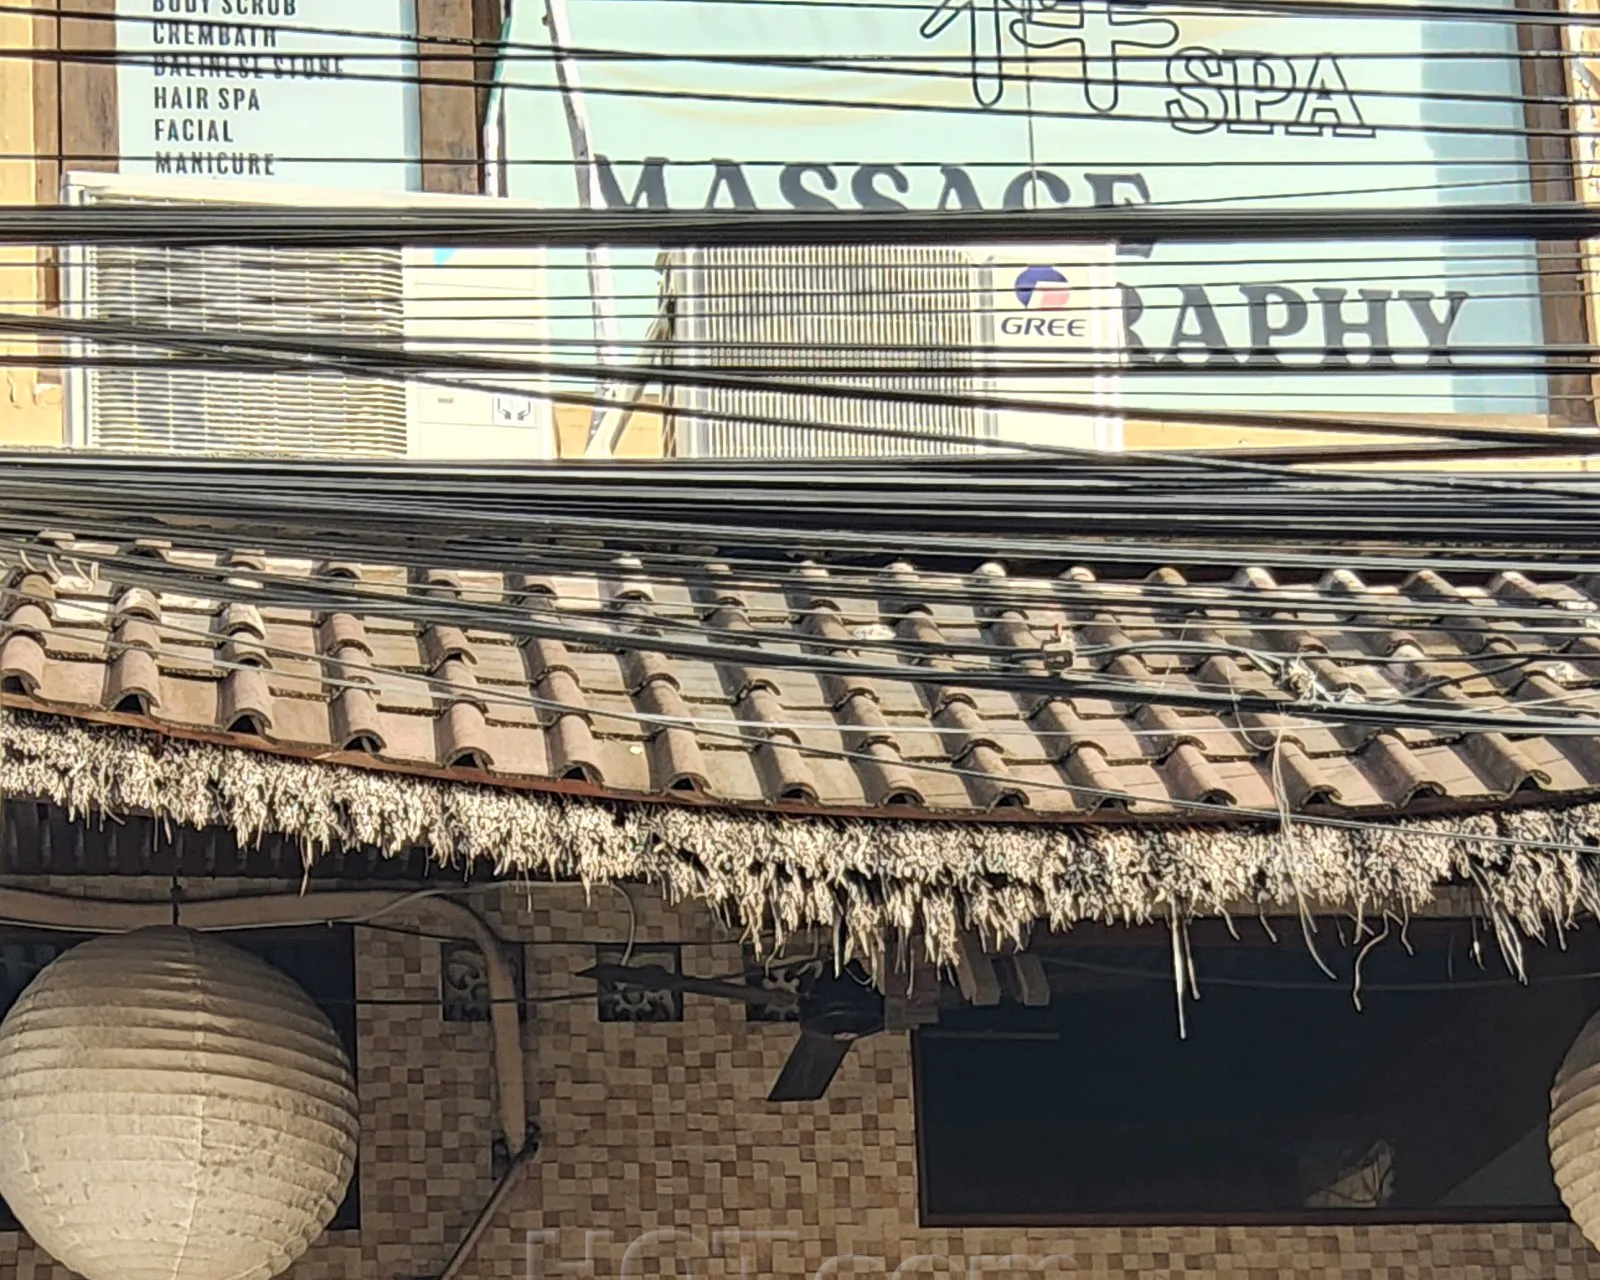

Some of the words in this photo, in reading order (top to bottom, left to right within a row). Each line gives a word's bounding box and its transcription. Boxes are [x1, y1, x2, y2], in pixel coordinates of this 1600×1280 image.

[153, 0, 209, 13] BODY
[221, 0, 297, 15] SCRUB
[153, 22, 276, 47] CREMBATH
[154, 86, 209, 109] HAIR
[218, 87, 260, 111] SPA
[1165, 46, 1377, 137] SPA
[155, 118, 234, 142] FACIAL
[155, 151, 275, 175] MANICURE
[1000, 316, 1087, 338] GREE
